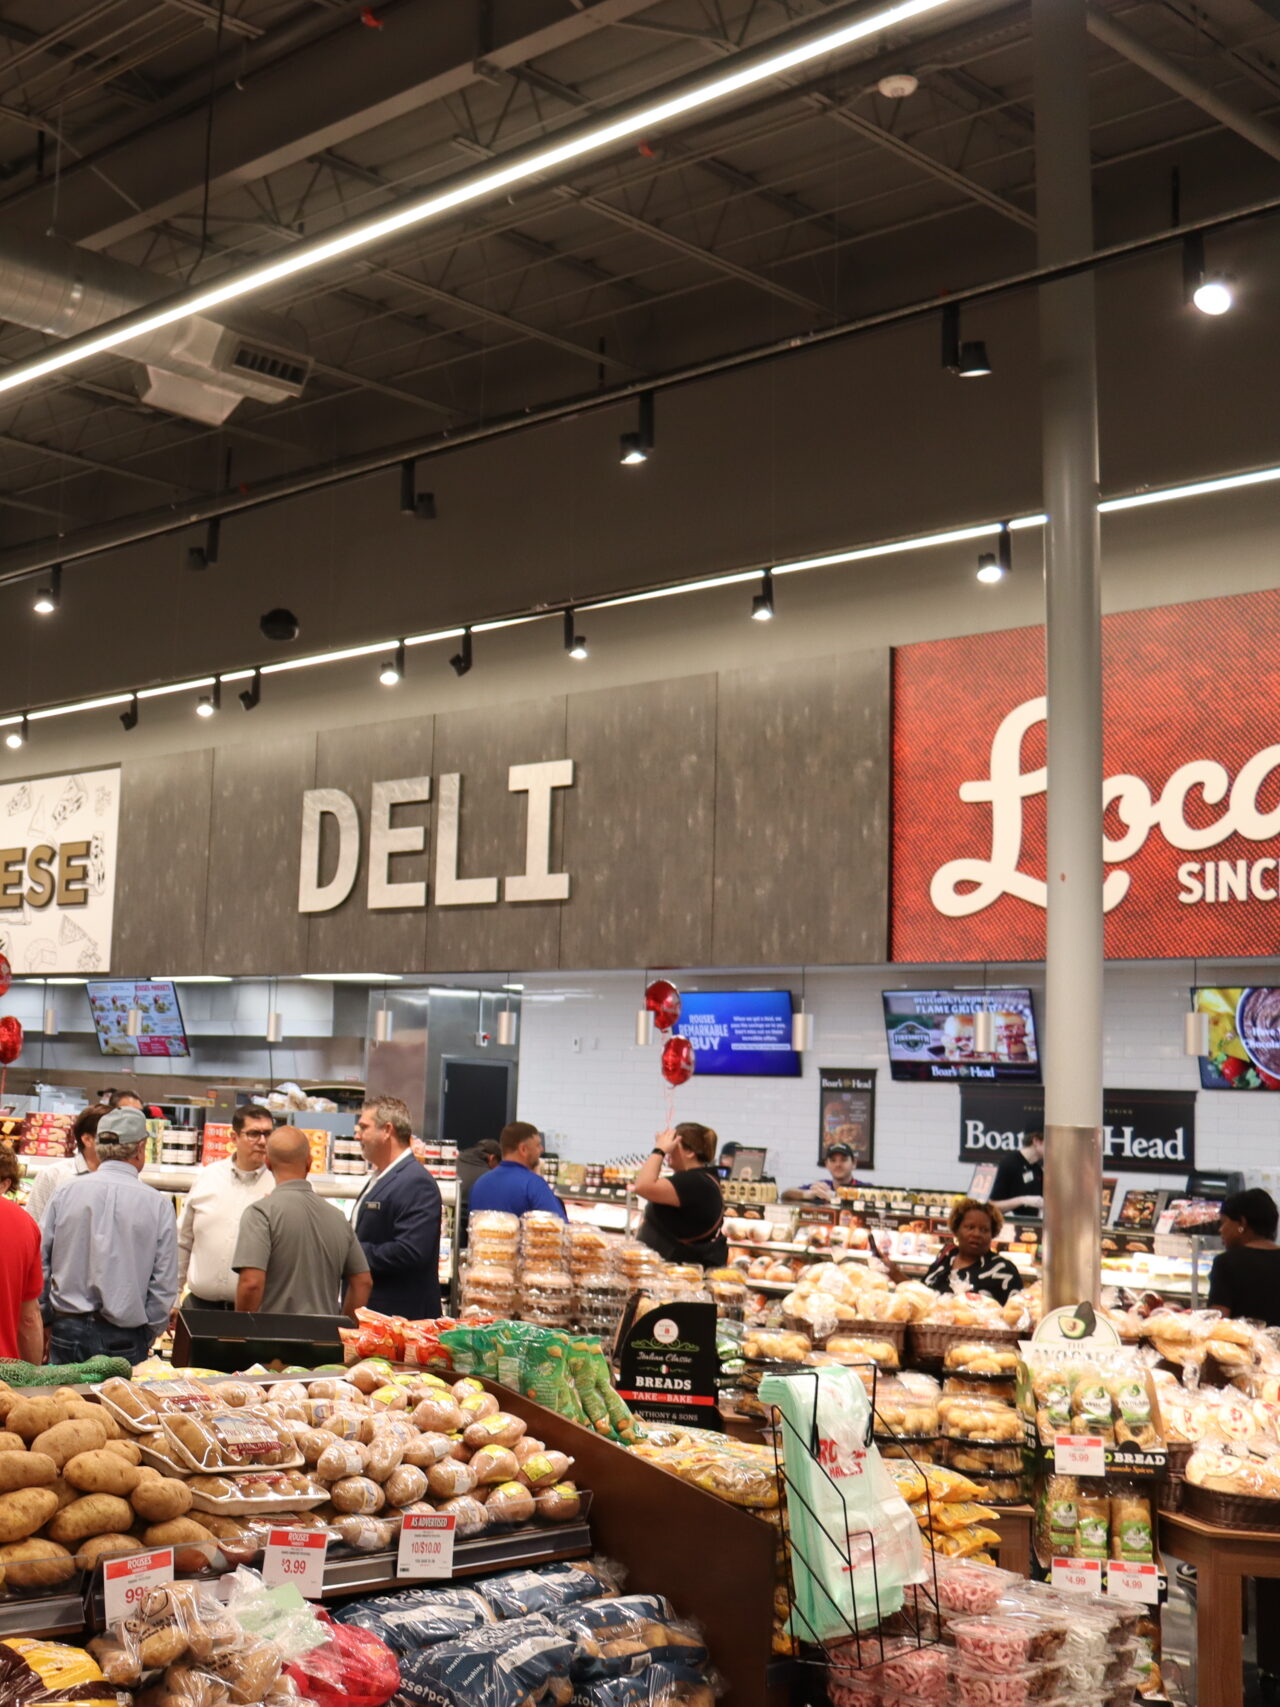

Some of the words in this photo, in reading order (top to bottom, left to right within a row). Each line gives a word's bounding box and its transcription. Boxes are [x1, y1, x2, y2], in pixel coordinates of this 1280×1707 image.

[298, 759, 573, 913] DELI
[1177, 857, 1280, 904] SINC
[916, 1004, 950, 1014] FLAME
[689, 1014, 715, 1024] ROUSES
[678, 1024, 729, 1037] REMARKABLE
[691, 1037, 720, 1050] BUY
[970, 1066, 995, 1078] Head
[852, 1079, 872, 1089] Head
[965, 1120, 1024, 1151] Boar
[1103, 1126, 1185, 1161] Head
[635, 1376, 692, 1390] BREADS
[632, 1391, 658, 1400] TAKE
[666, 1395, 693, 1404] BAKE
[634, 1410, 671, 1419] ANTHONY
[678, 1413, 698, 1421] SONS
[1114, 1453, 1166, 1465] BREAD
[419, 1517, 448, 1527] ADVERTISED
[128, 1556, 152, 1569] ROUSES
[281, 1558, 306, 1574] $3.99
[462, 1662, 485, 1687] mashing
